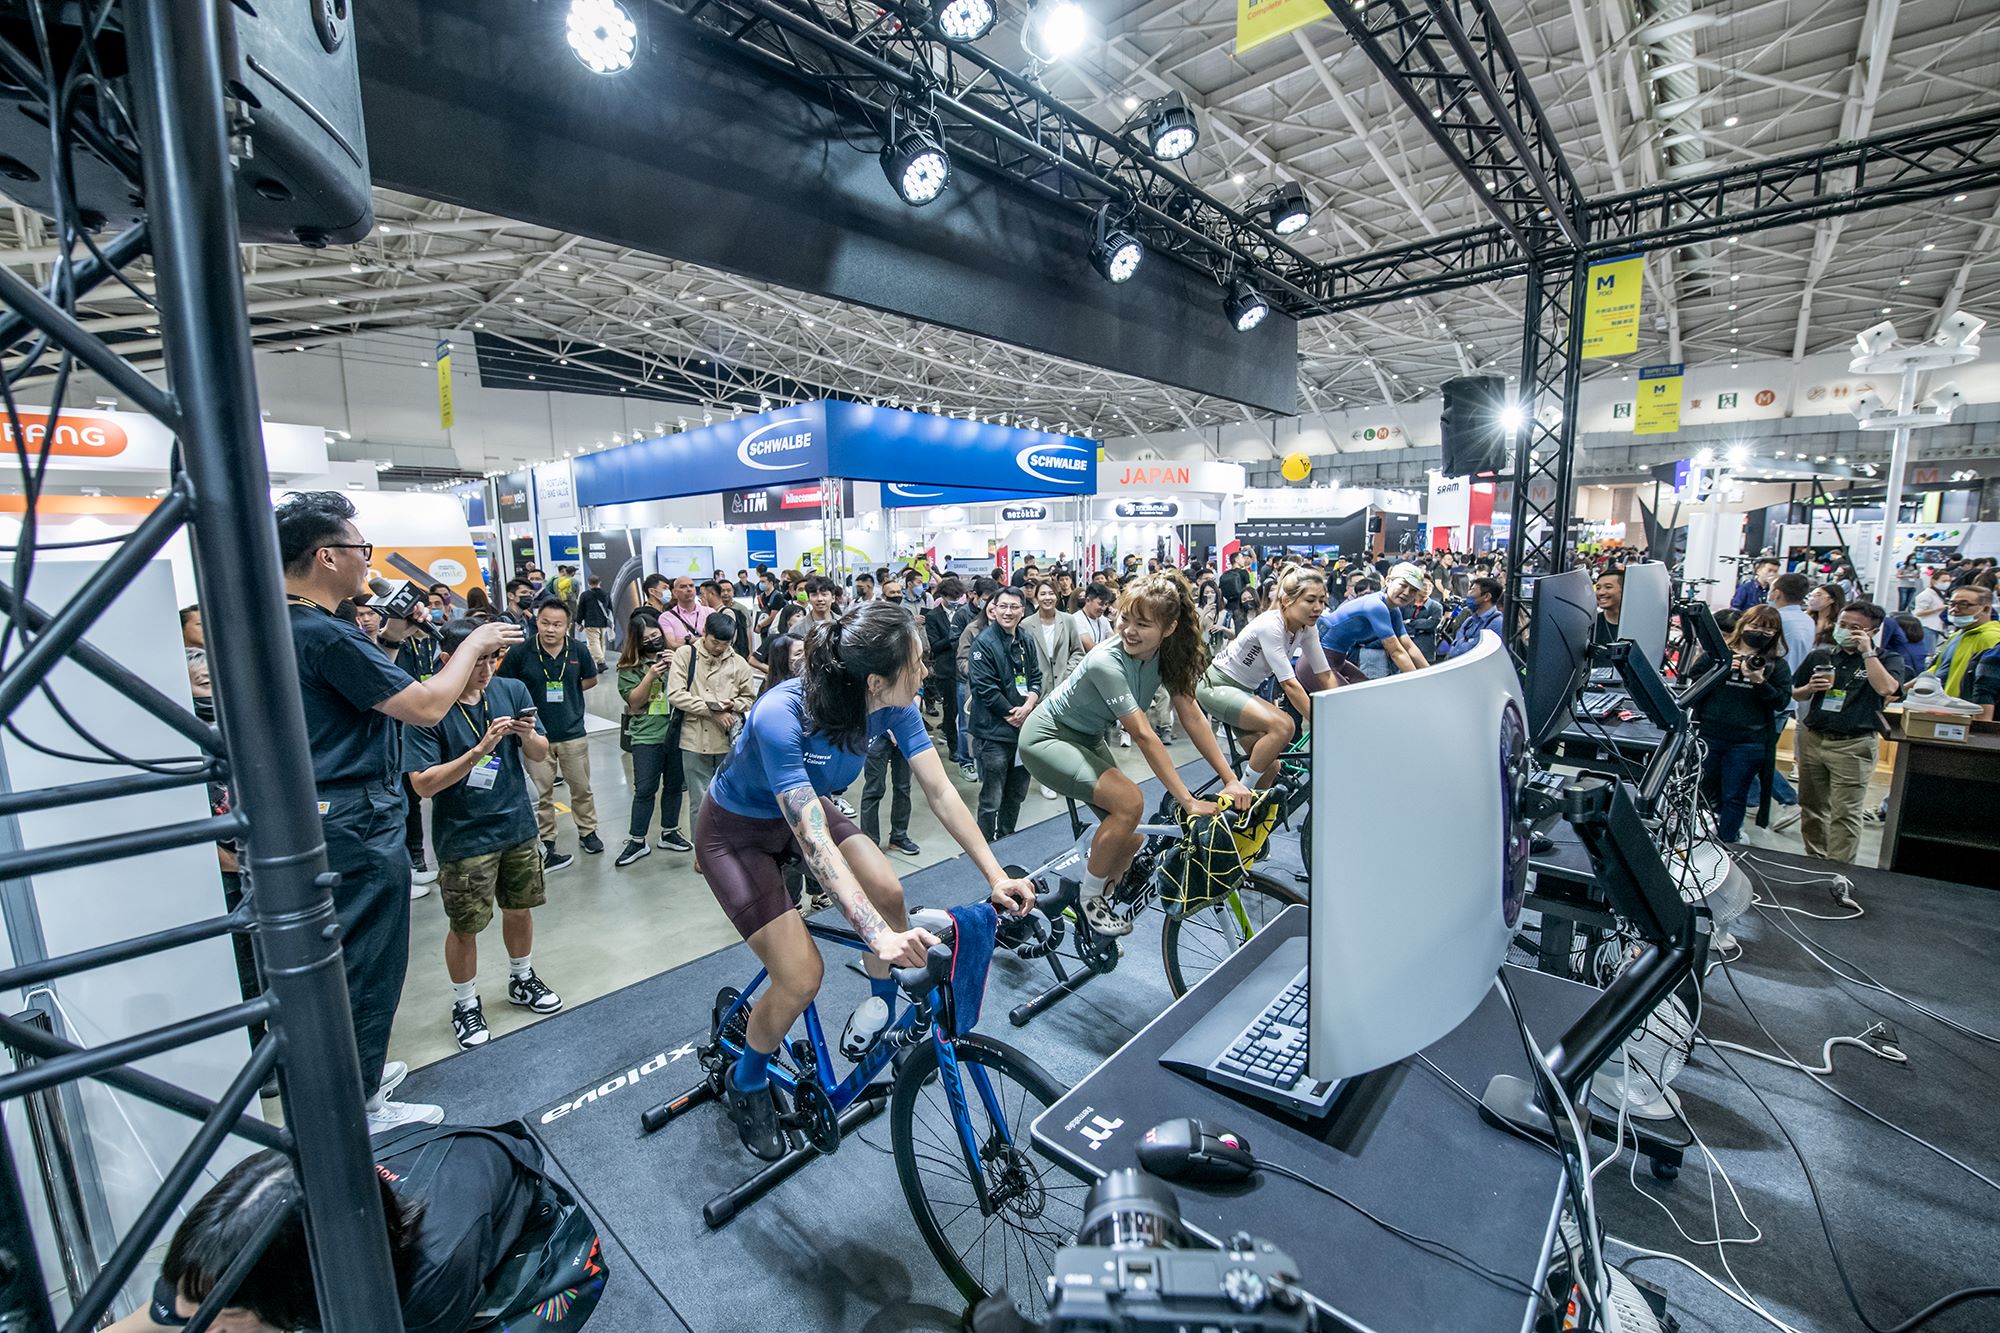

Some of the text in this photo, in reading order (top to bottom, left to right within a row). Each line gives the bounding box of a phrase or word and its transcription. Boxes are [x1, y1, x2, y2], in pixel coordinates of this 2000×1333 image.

[1597, 274, 1615, 290] M
[1653, 384, 1666, 394] M
[0, 422, 106, 447] FANG
[749, 432, 812, 457] SCHWALBE
[1029, 454, 1088, 471] SCHWALBE
[1119, 467, 1190, 485] JAPAN
[1436, 483, 1460, 494] SRAM
[743, 492, 768, 513] ITM
[1242, 645, 1263, 668] RAPHA
[806, 758, 826, 766] Colours
[808, 752, 832, 760] Universal
[540, 1041, 697, 1125] xplova
[940, 1044, 970, 1125] TIME
